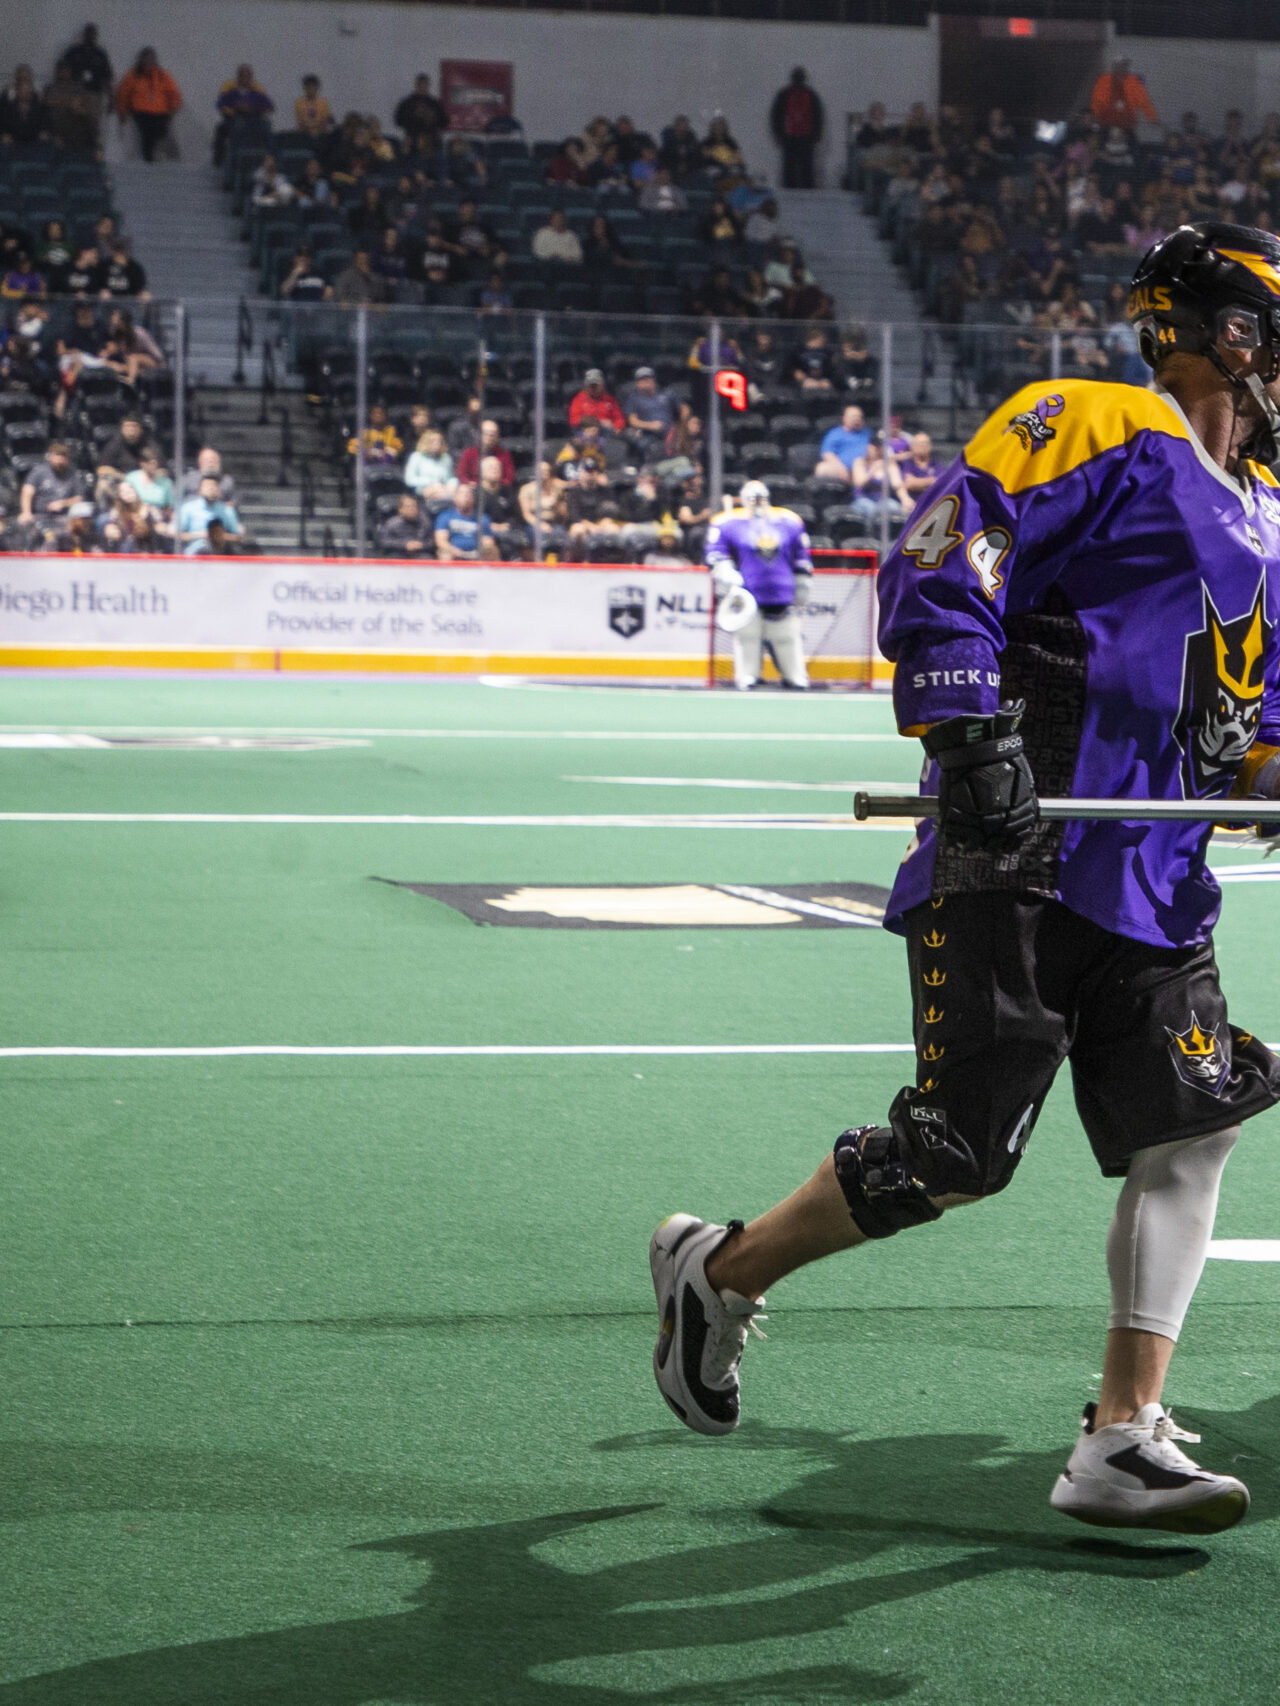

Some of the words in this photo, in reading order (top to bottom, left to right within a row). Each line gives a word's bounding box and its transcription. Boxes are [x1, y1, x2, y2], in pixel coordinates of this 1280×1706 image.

[1127, 286, 1173, 319] EALS
[1159, 327, 1177, 344] 44
[714, 370, 747, 411] 9
[0, 583, 64, 621] iego
[72, 581, 169, 614] Health
[273, 581, 347, 603] Official
[355, 583, 423, 604] Health
[430, 584, 477, 605] Care
[656, 593, 711, 613] NLL
[267, 611, 354, 633] Provider
[362, 612, 385, 633] of
[391, 614, 424, 634] the
[432, 614, 483, 636] Seals
[913, 669, 982, 688] STICK
[997, 736, 1023, 752] EPOC
